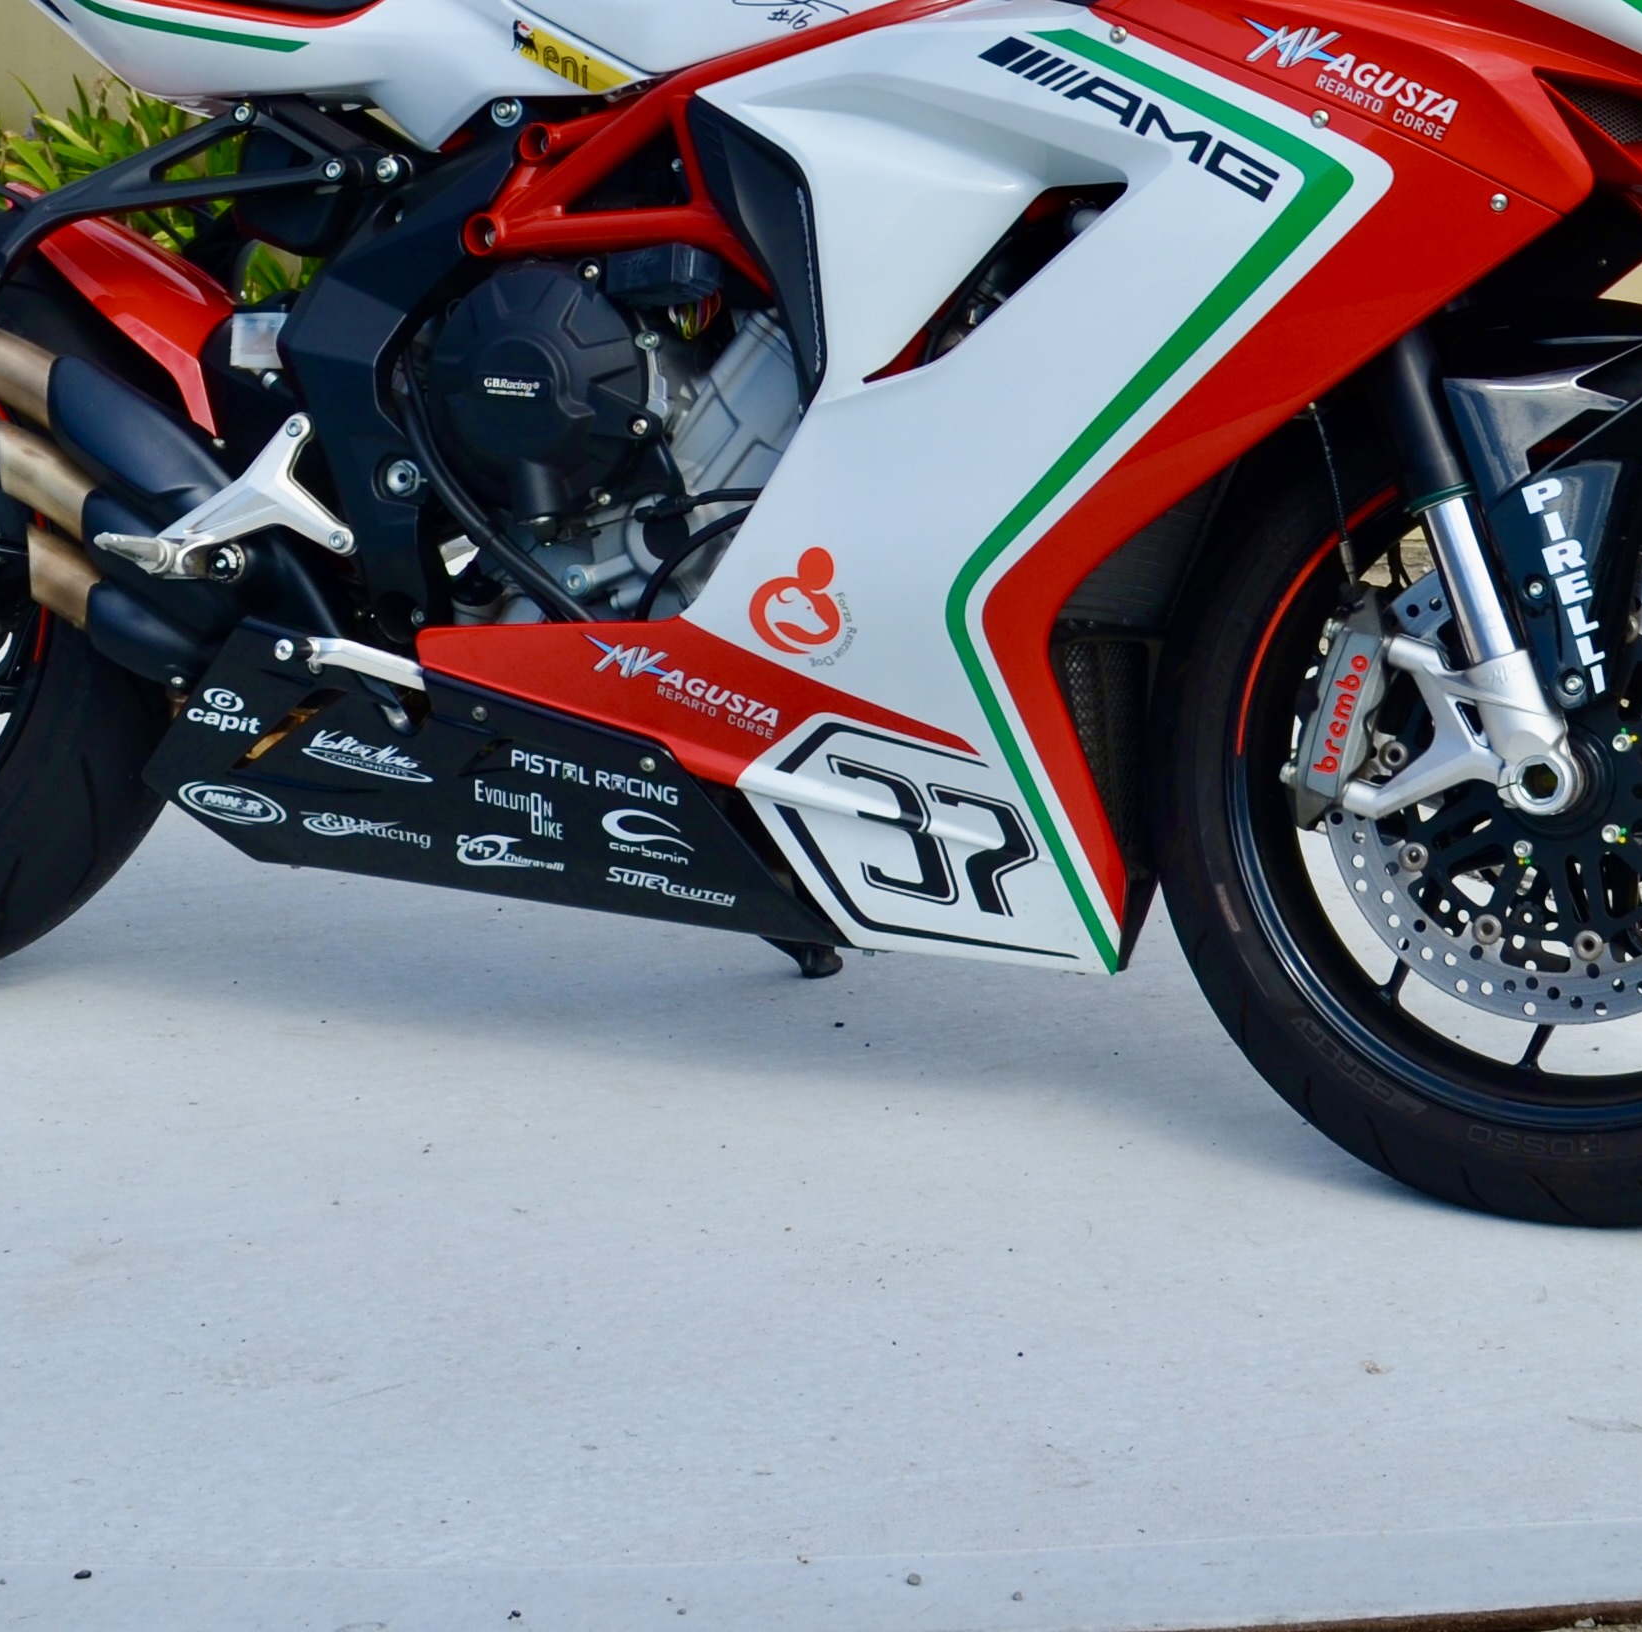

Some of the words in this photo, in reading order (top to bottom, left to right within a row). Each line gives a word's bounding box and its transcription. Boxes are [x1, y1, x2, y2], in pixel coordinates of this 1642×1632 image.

[766, 8, 814, 30] #16
[542, 45, 590, 90] eni
[1244, 24, 1344, 69] MV
[1322, 52, 1460, 126] AGUSTA
[1314, 73, 1385, 115] REPARTO
[1391, 107, 1447, 142] CORSE
[1061, 75, 1281, 203] AMG
[1520, 477, 1607, 695] PIRELLI
[835, 591, 853, 623] Forza
[832, 626, 858, 658] Rescue
[592, 643, 669, 679] MV
[658, 668, 780, 729] AGUSTA
[186, 707, 262, 735] capit
[657, 684, 718, 718] REPARTO
[726, 713, 775, 741] CORSE
[1313, 654, 1369, 776] brembo
[322, 752, 409, 778] COMPONENTS
[474, 779, 553, 819] EVOLUTION
[595, 770, 679, 806] RACING
[320, 811, 432, 850] GBRacing
[826, 753, 1039, 918] 37
[456, 834, 495, 858] CHT
[503, 852, 565, 872] Chiaravalli
[608, 841, 689, 866] carbonin
